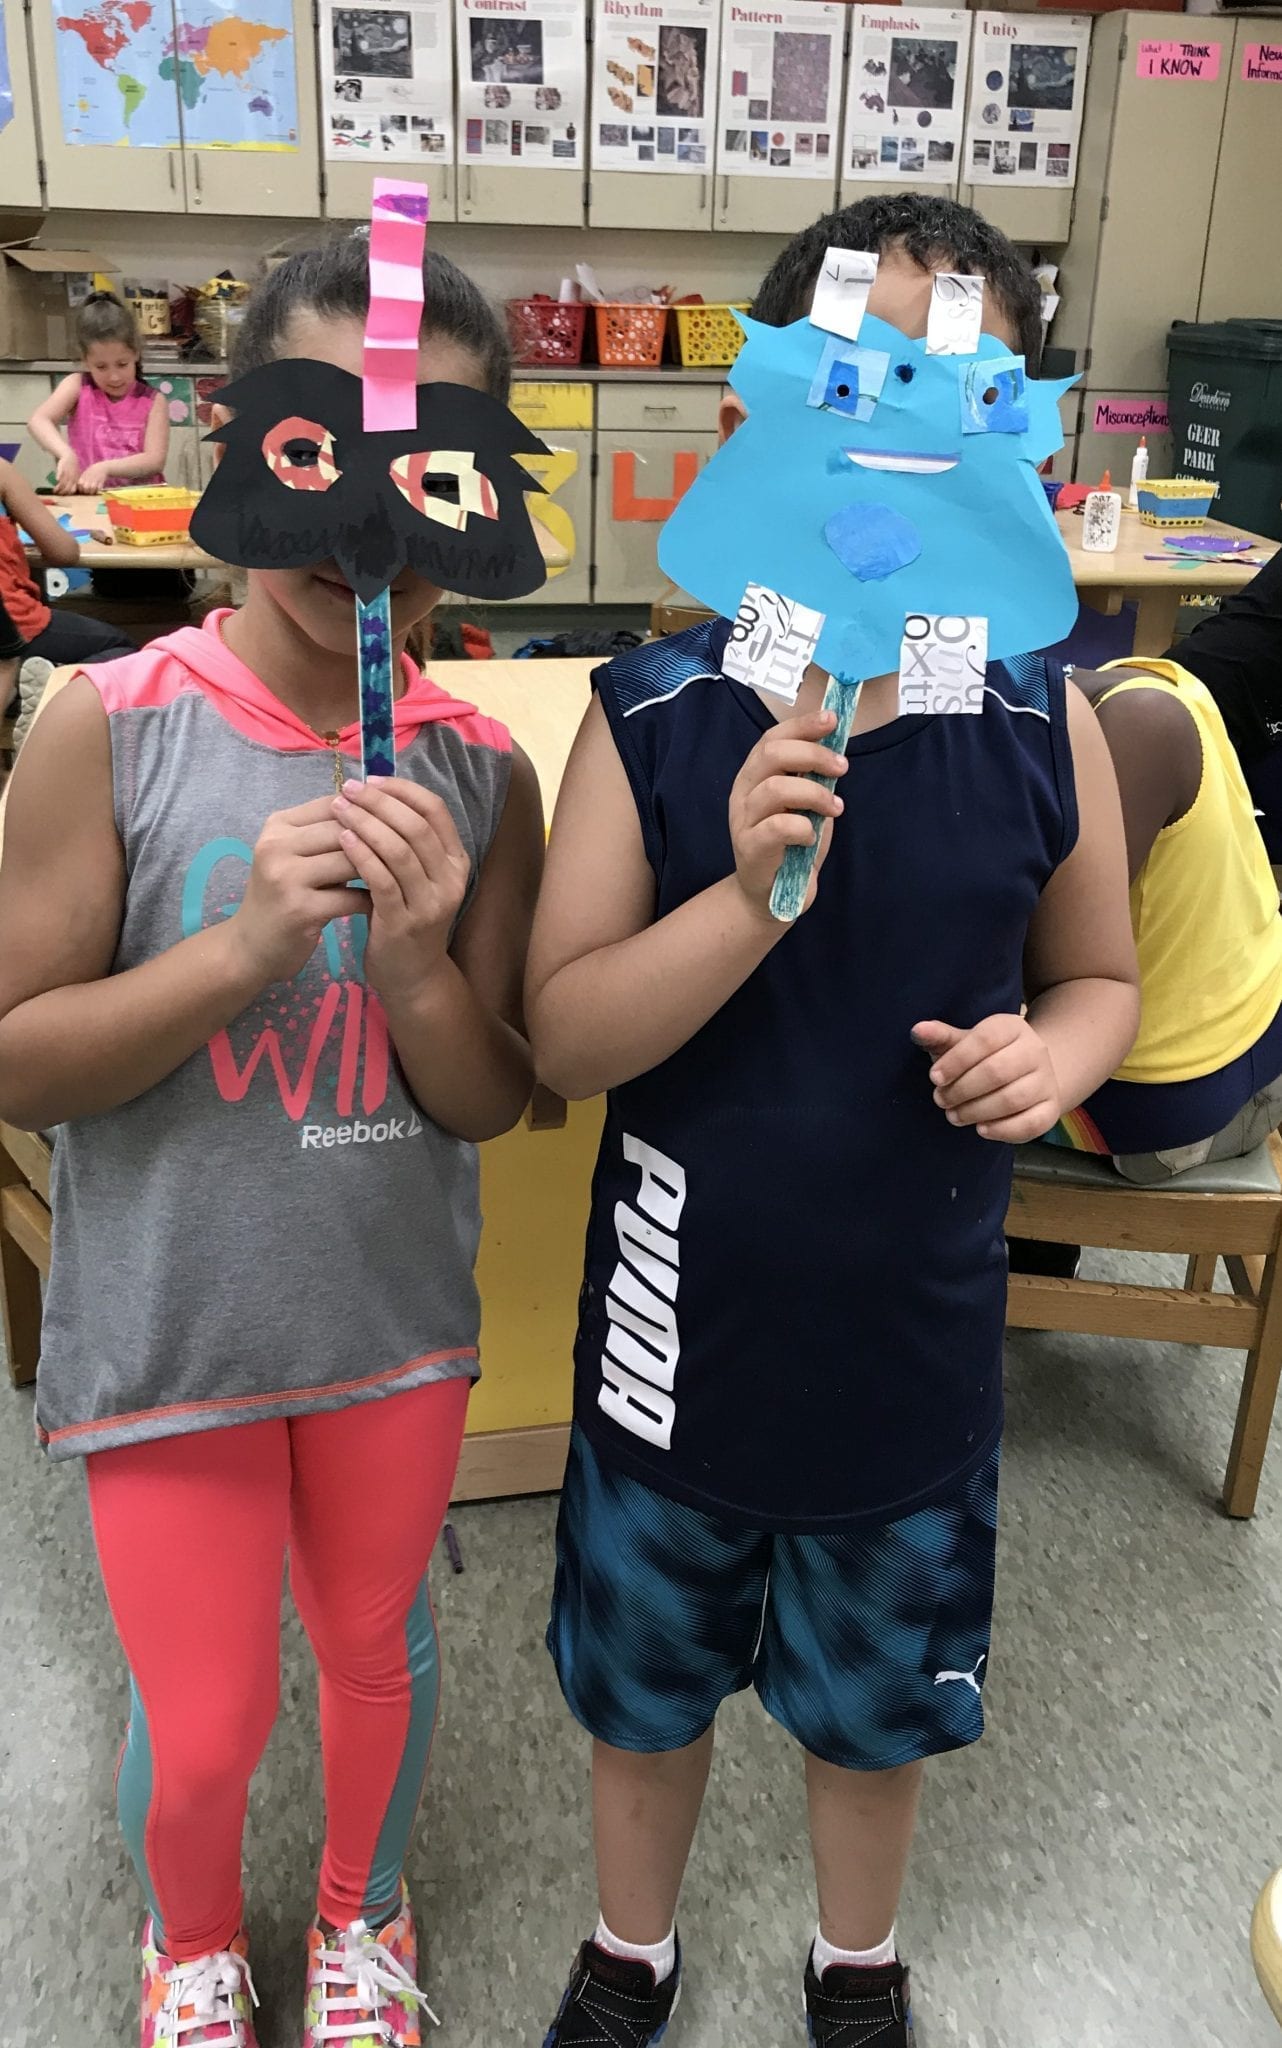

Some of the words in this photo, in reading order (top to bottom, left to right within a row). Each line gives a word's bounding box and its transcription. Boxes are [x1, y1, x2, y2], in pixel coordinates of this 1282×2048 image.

[604, 0, 663, 18] Rhythm
[731, 7, 783, 24] Pattern
[861, 14, 920, 32] Emphasis
[983, 21, 1019, 39] Unity
[1179, 43, 1211, 58] THINK
[1149, 58, 1154, 75] I
[1160, 58, 1203, 76] KNOW
[1189, 382, 1231, 408] Dearborn
[1187, 423, 1221, 448] GEER
[1183, 447, 1216, 472] PARK
[300, 1117, 406, 1149] Reebok
[597, 1131, 688, 1451] PUMA
